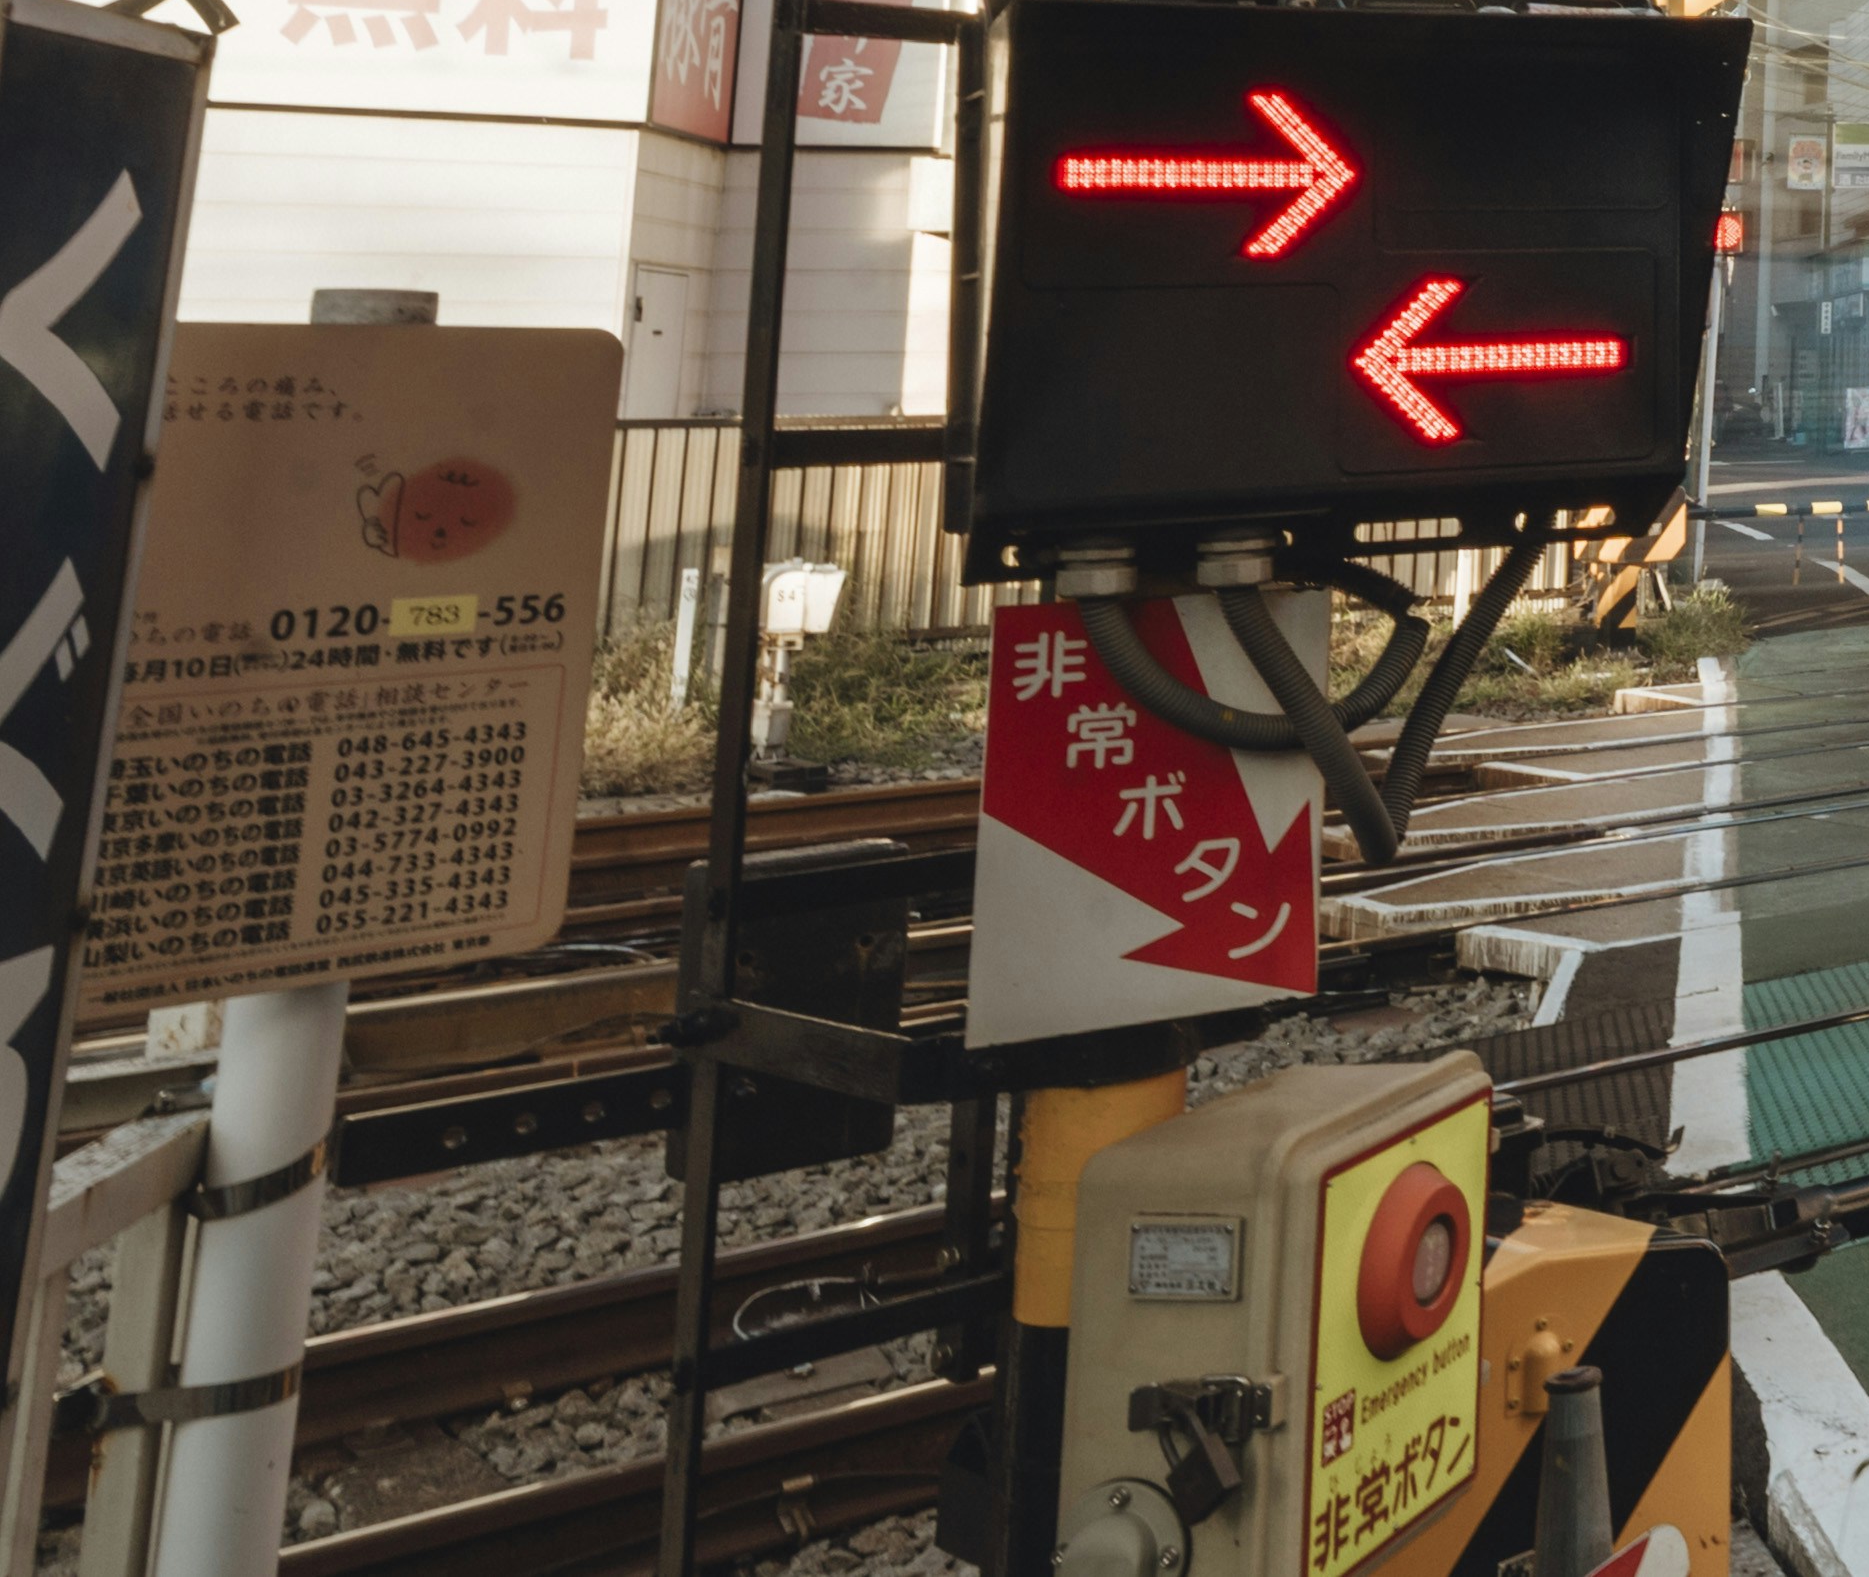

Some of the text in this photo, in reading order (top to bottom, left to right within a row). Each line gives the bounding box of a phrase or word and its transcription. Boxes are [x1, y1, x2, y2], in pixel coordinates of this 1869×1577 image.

[337, 721, 527, 759] 048-645-4343
[334, 746, 526, 785] 043-227-3900
[330, 769, 522, 809] 03-3264-4343
[1012, 630, 1291, 960] 非常ボタン
[318, 865, 511, 909] 045-335-4343
[315, 891, 508, 935] 055-221-4343
[1360, 1333, 1470, 1426] Emergency button
[1313, 1414, 1471, 1572] 非常ボタン
